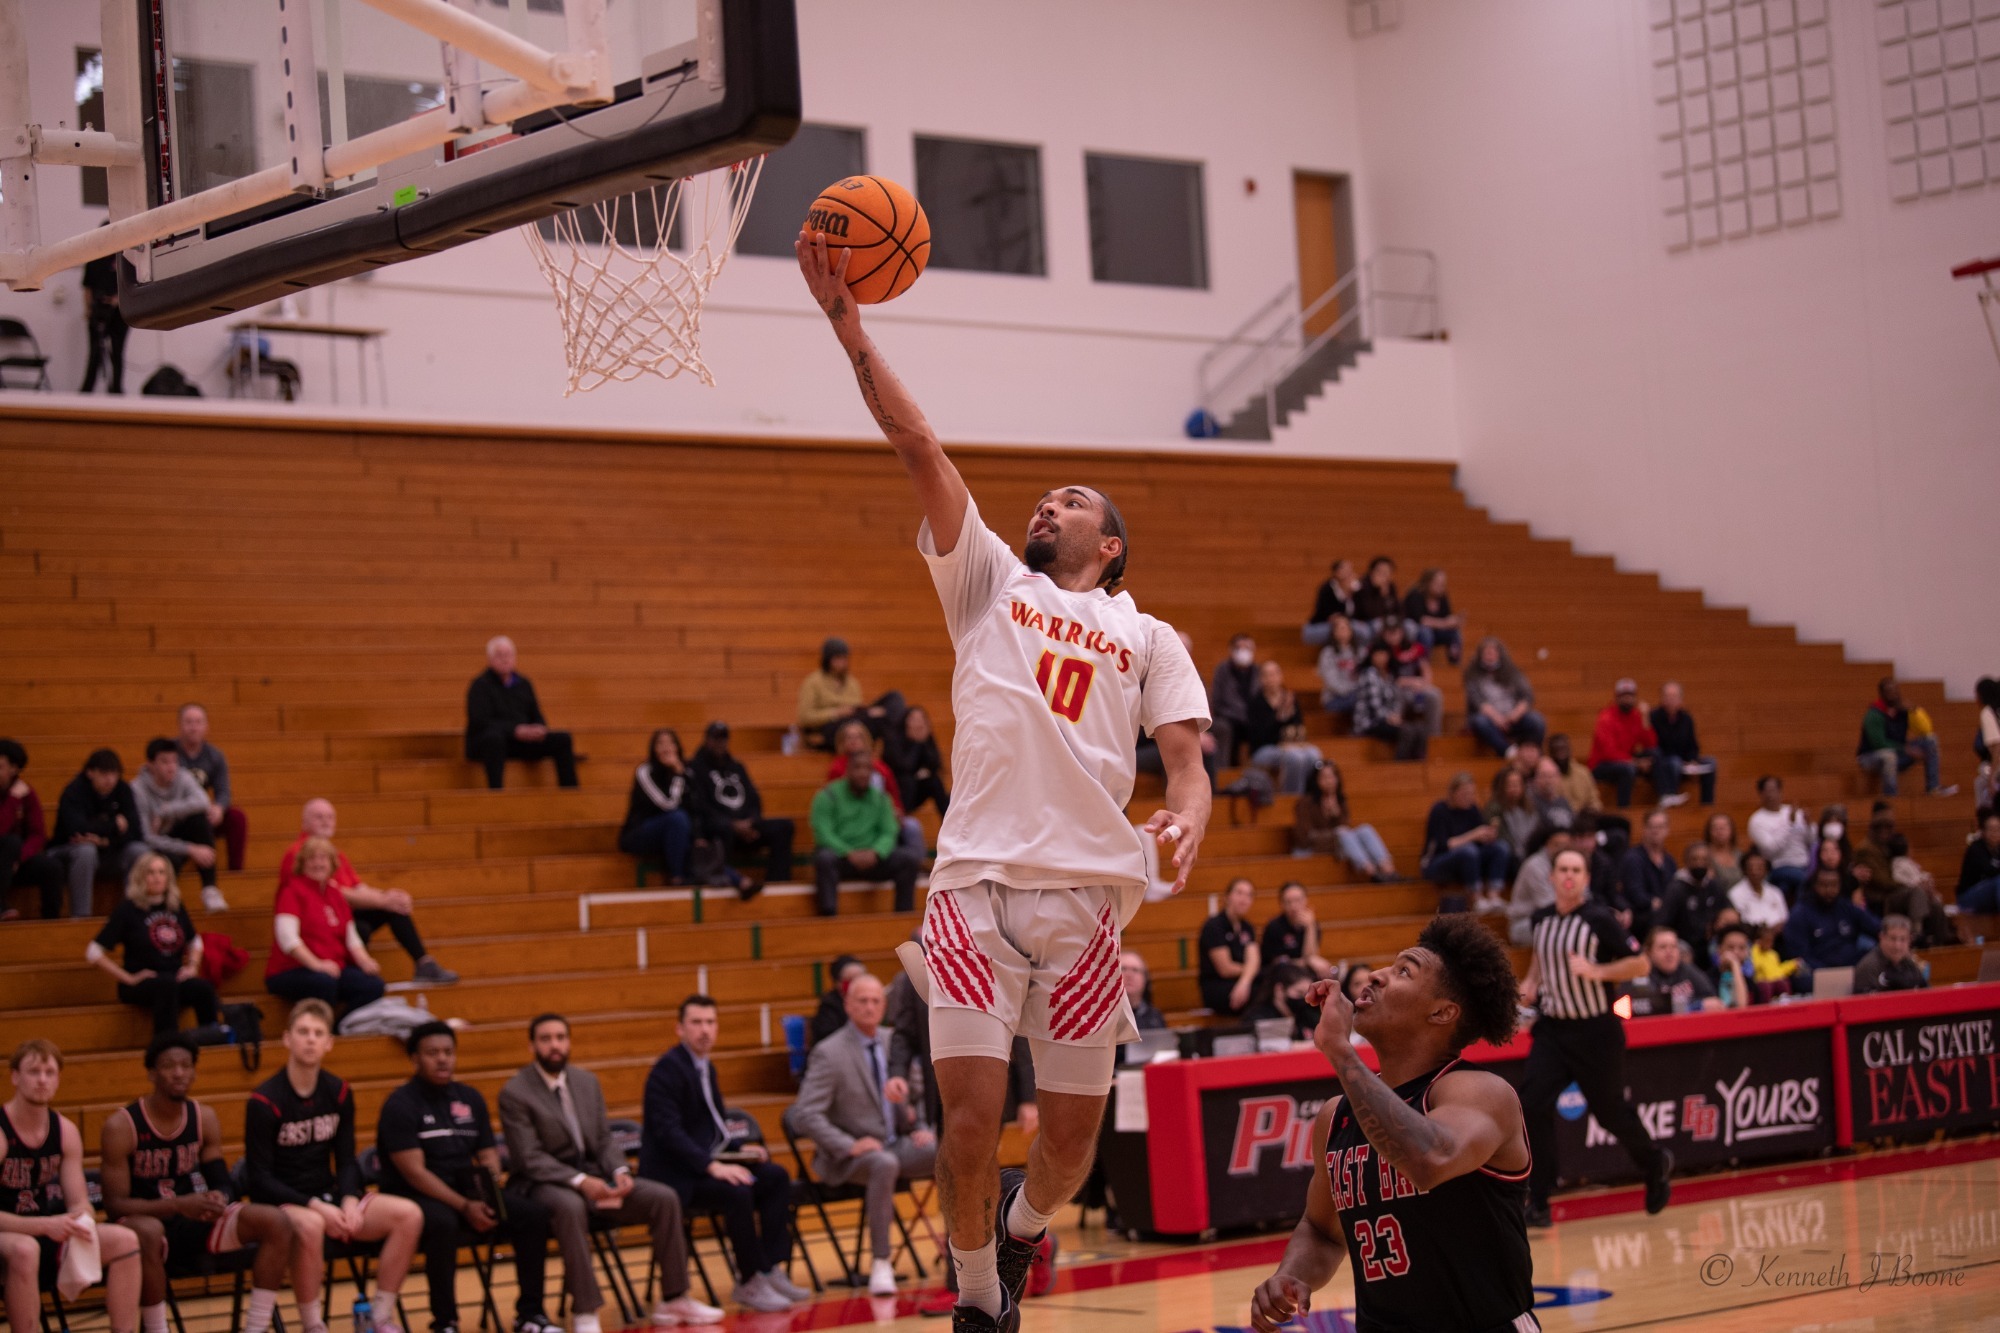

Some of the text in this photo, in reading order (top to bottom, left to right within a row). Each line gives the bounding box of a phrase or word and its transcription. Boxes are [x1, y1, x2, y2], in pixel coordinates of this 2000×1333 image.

[1035, 648, 1098, 725] 10
[1863, 1019, 1995, 1069] CAL STATE
[1865, 1056, 1977, 1126] EAST
[1377, 1152, 1430, 1202] BA
[1354, 1213, 1411, 1283] 23
